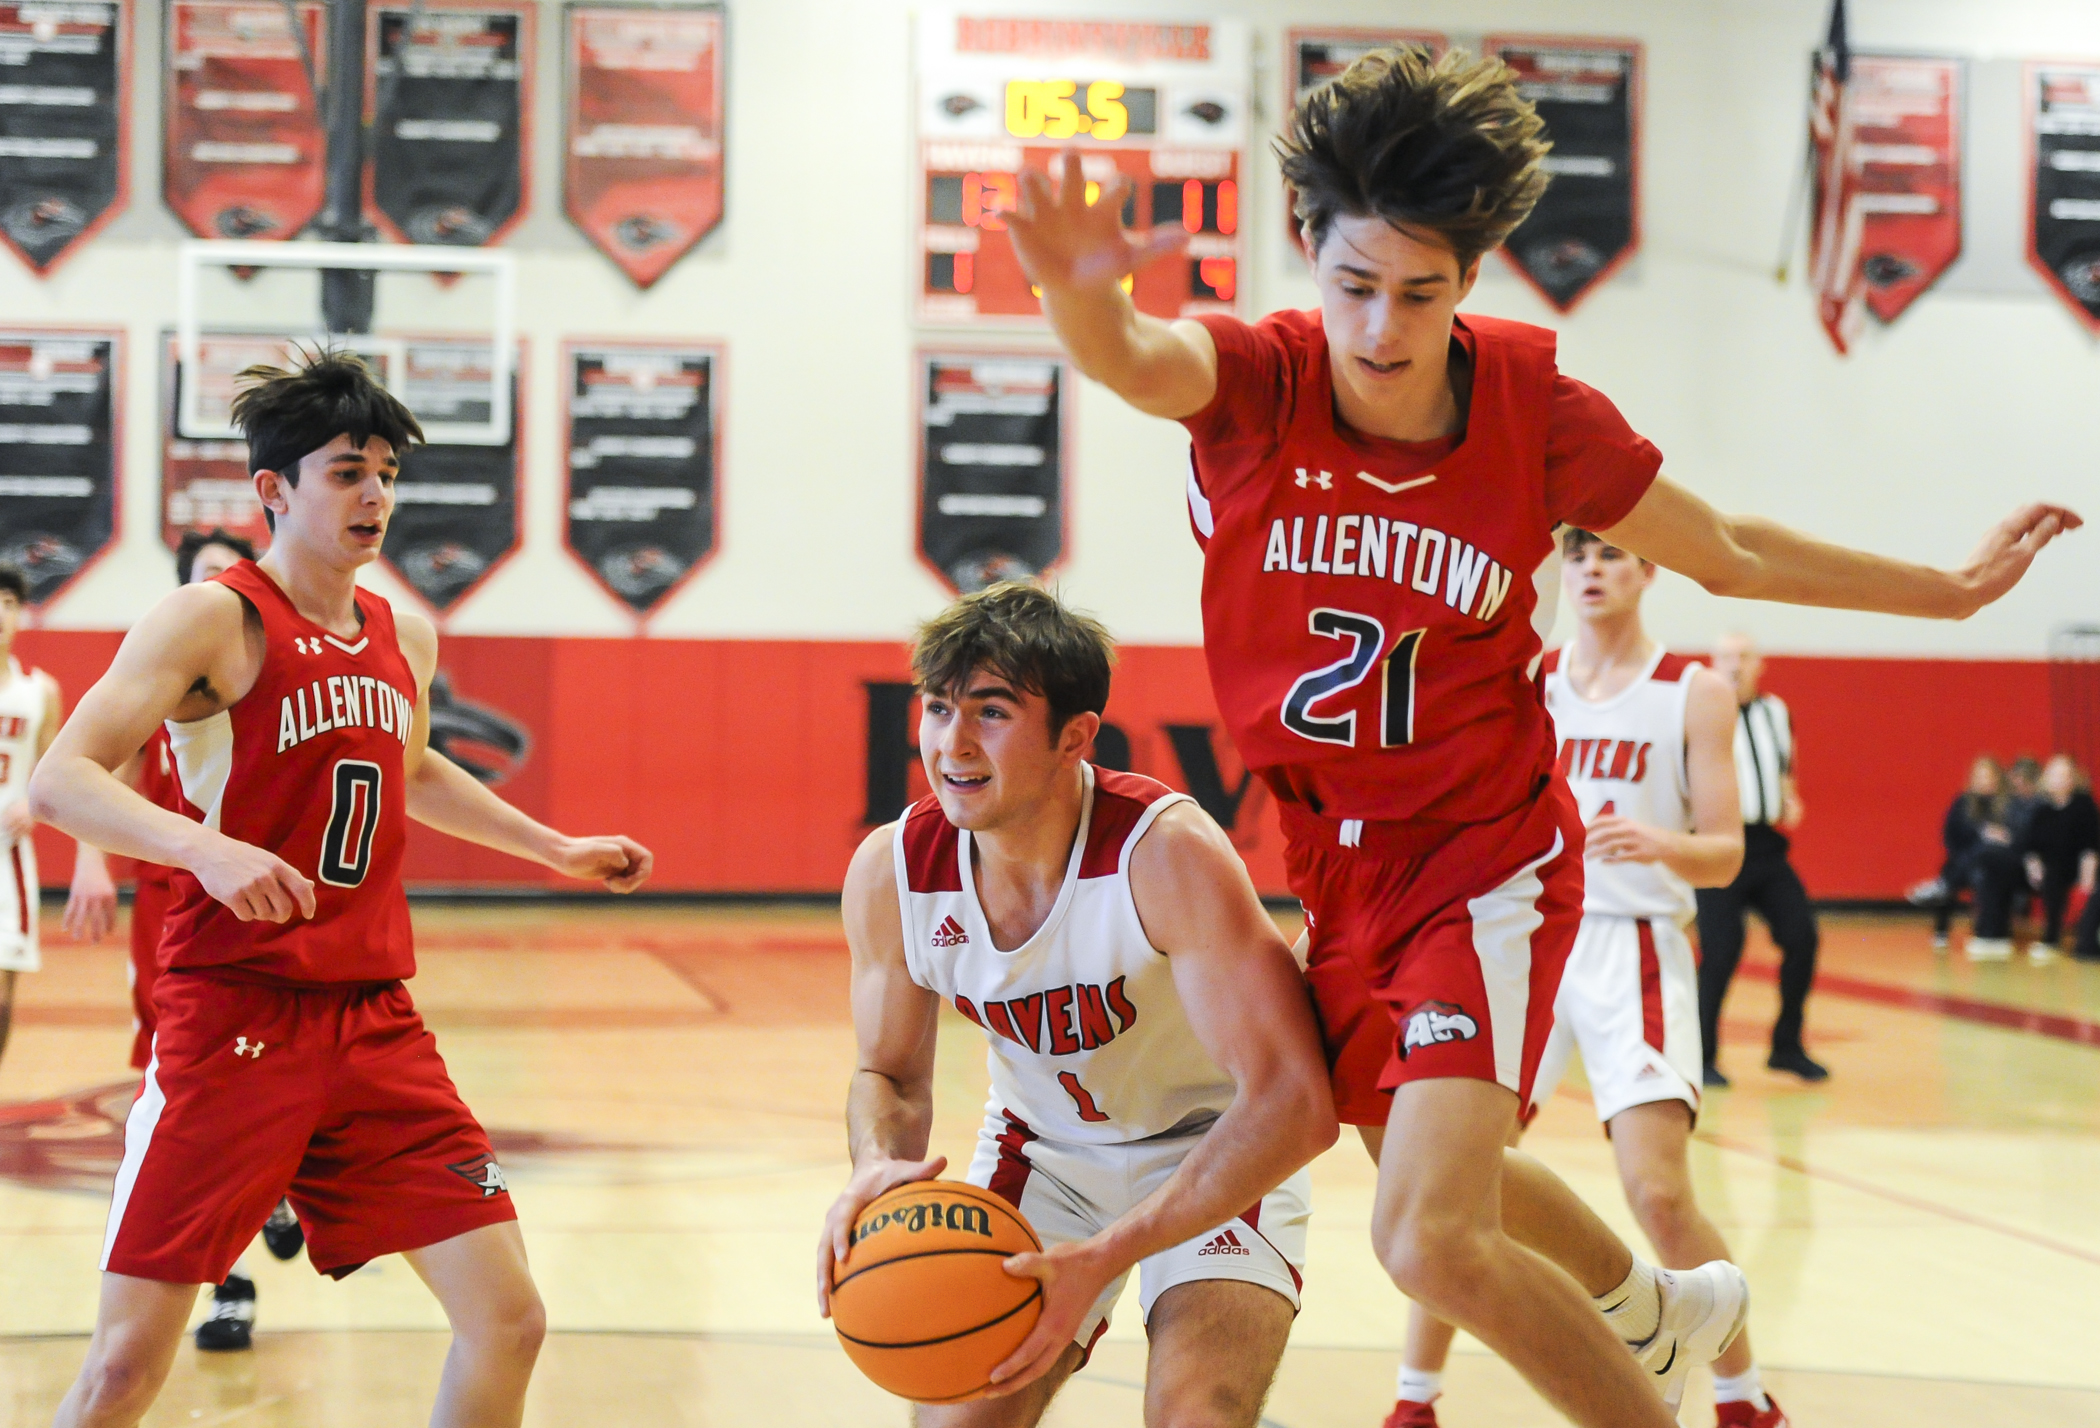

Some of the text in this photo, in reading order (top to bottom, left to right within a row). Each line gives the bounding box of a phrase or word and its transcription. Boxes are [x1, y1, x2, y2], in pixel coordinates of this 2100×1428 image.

[1005, 79, 1128, 140] 05.5
[1183, 179, 1237, 234] 11
[1263, 514, 1513, 622] ALLENTOWN
[1281, 607, 1428, 748] 21
[1558, 738, 1653, 783] AVENS
[319, 758, 382, 888] 0
[931, 934, 969, 947] adidas
[1057, 1070, 1111, 1122] 1
[849, 1203, 993, 1249] Wilson
[1198, 1244, 1250, 1256] adidas
